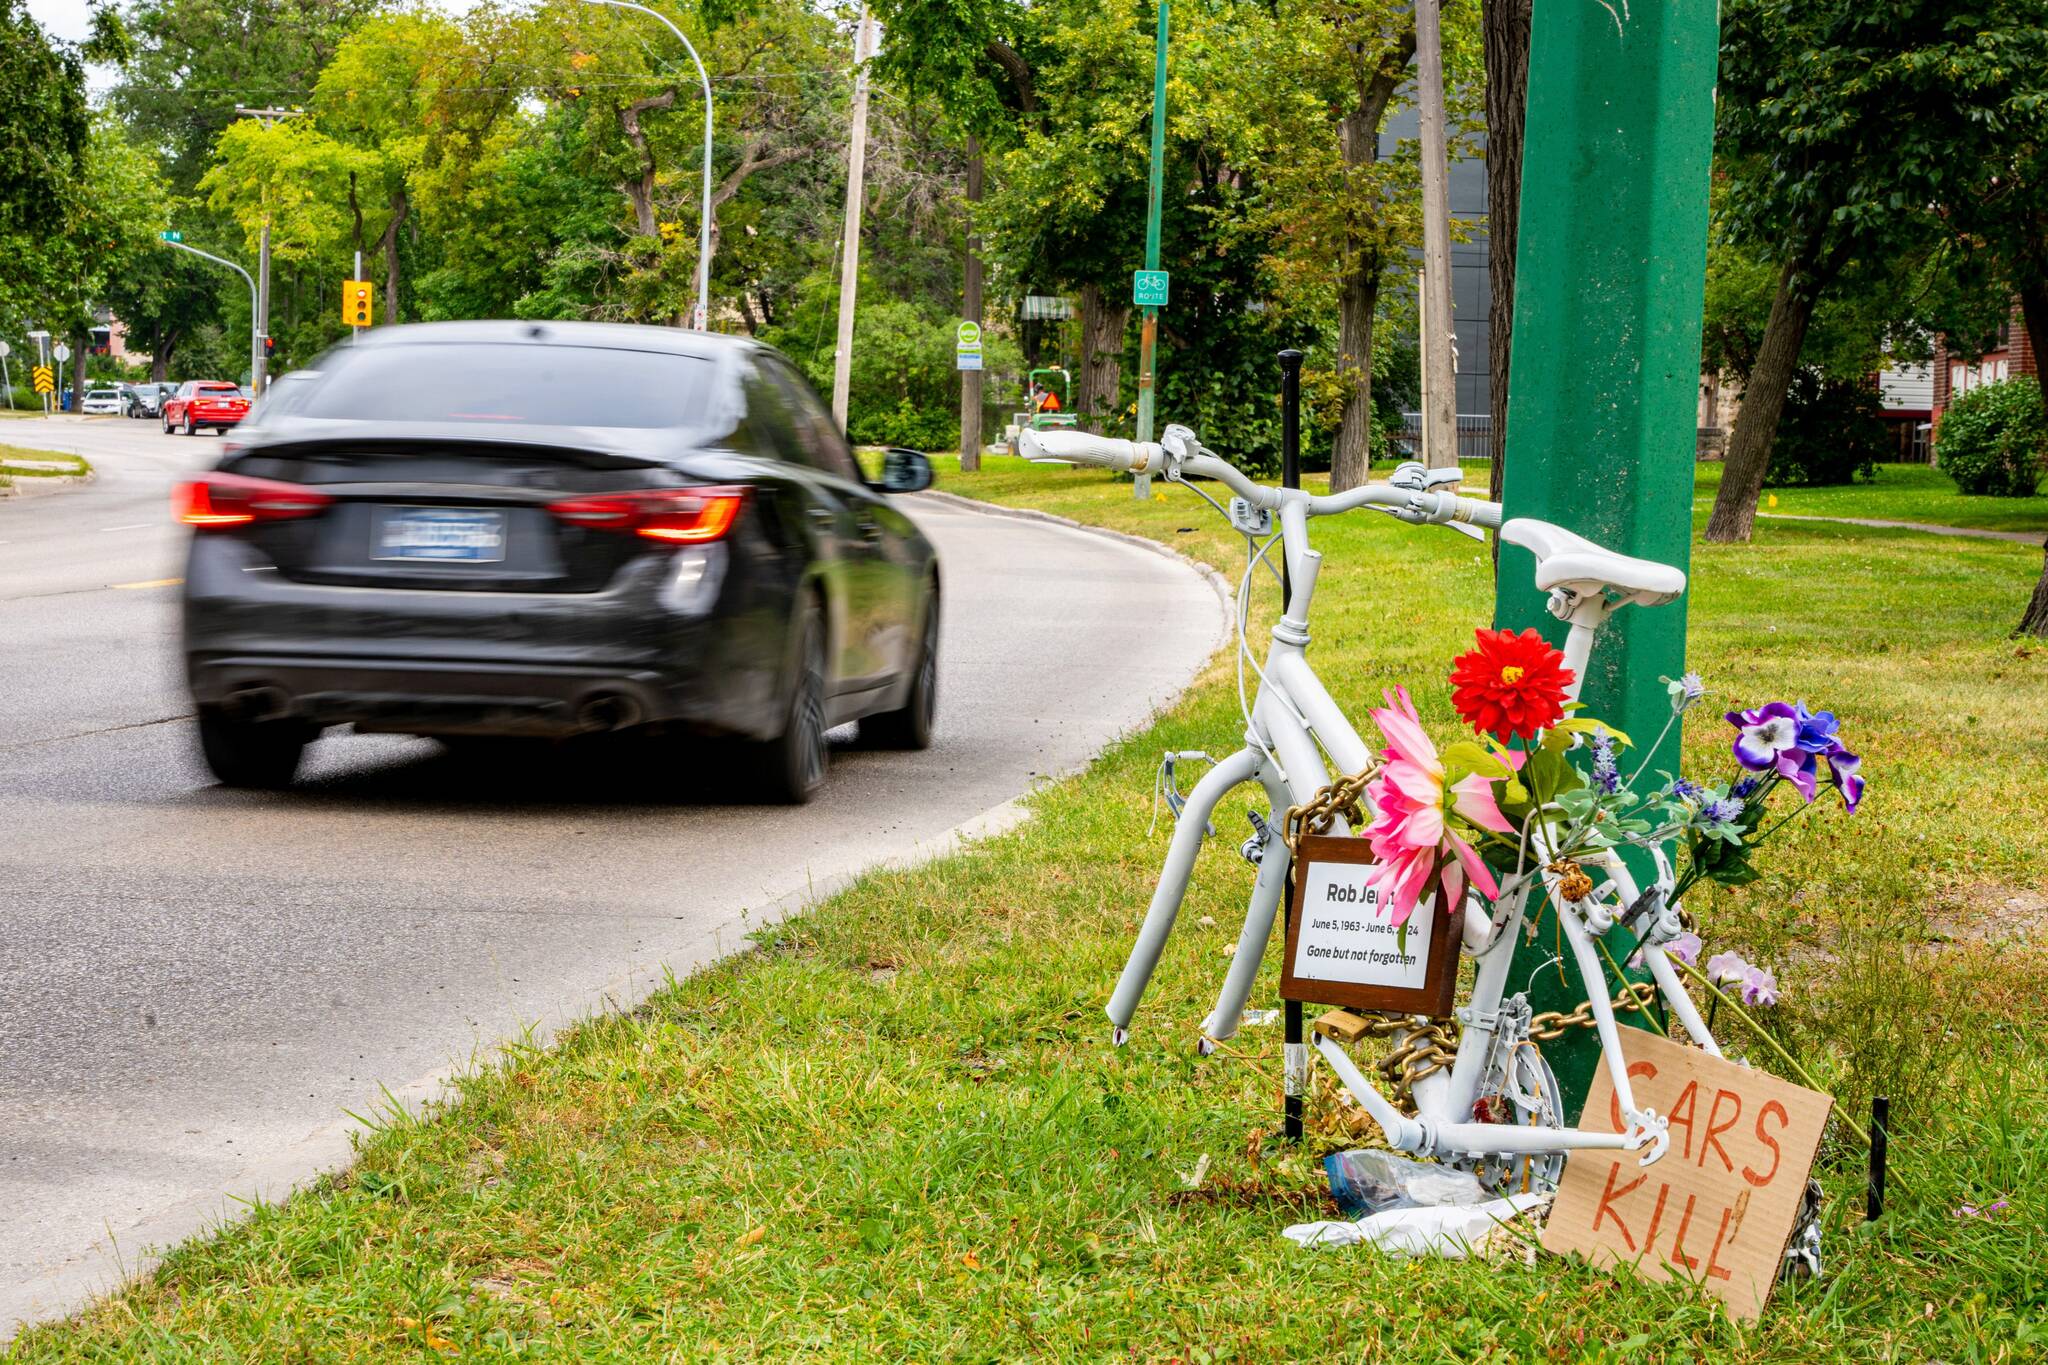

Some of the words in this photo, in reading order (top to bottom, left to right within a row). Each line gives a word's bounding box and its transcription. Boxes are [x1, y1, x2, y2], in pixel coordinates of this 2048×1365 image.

[172, 231, 180, 240] N
[1138, 292, 1164, 300] ROUTE
[1326, 883, 1357, 903] Rob
[1311, 918, 1331, 930] June
[1331, 920, 1340, 932] 5,
[1341, 920, 1361, 932] 1963
[1365, 922, 1386, 934] June
[1386, 924, 1395, 936] 6,
[1396, 924, 1419, 936] 24
[1307, 945, 1331, 958] Gone
[1332, 946, 1350, 960] but
[1350, 949, 1368, 961] not
[1368, 949, 1416, 966] forgotten
